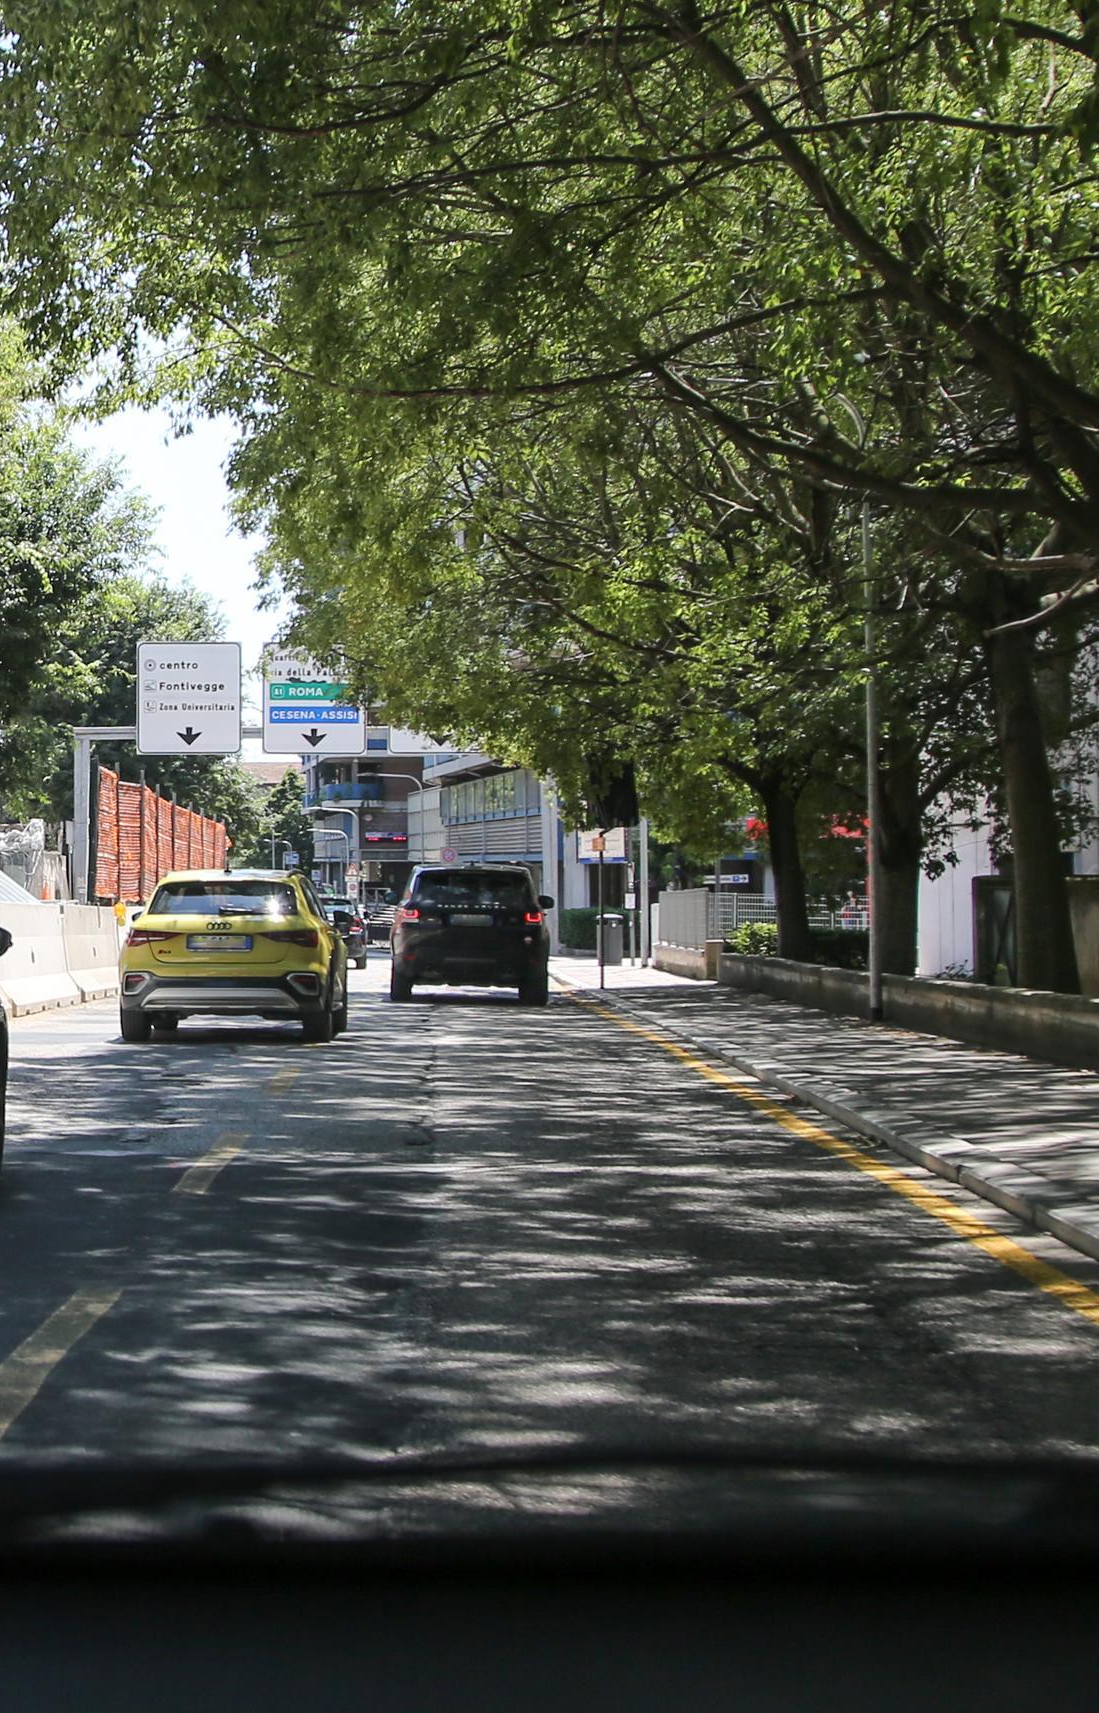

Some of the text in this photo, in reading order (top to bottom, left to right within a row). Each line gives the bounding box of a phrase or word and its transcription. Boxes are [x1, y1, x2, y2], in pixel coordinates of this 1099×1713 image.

[159, 661, 199, 670] centro
[287, 667, 311, 676] della
[159, 681, 225, 692] Fontivegge
[288, 687, 324, 696] ROMA
[159, 702, 235, 711] Zona Universitaria
